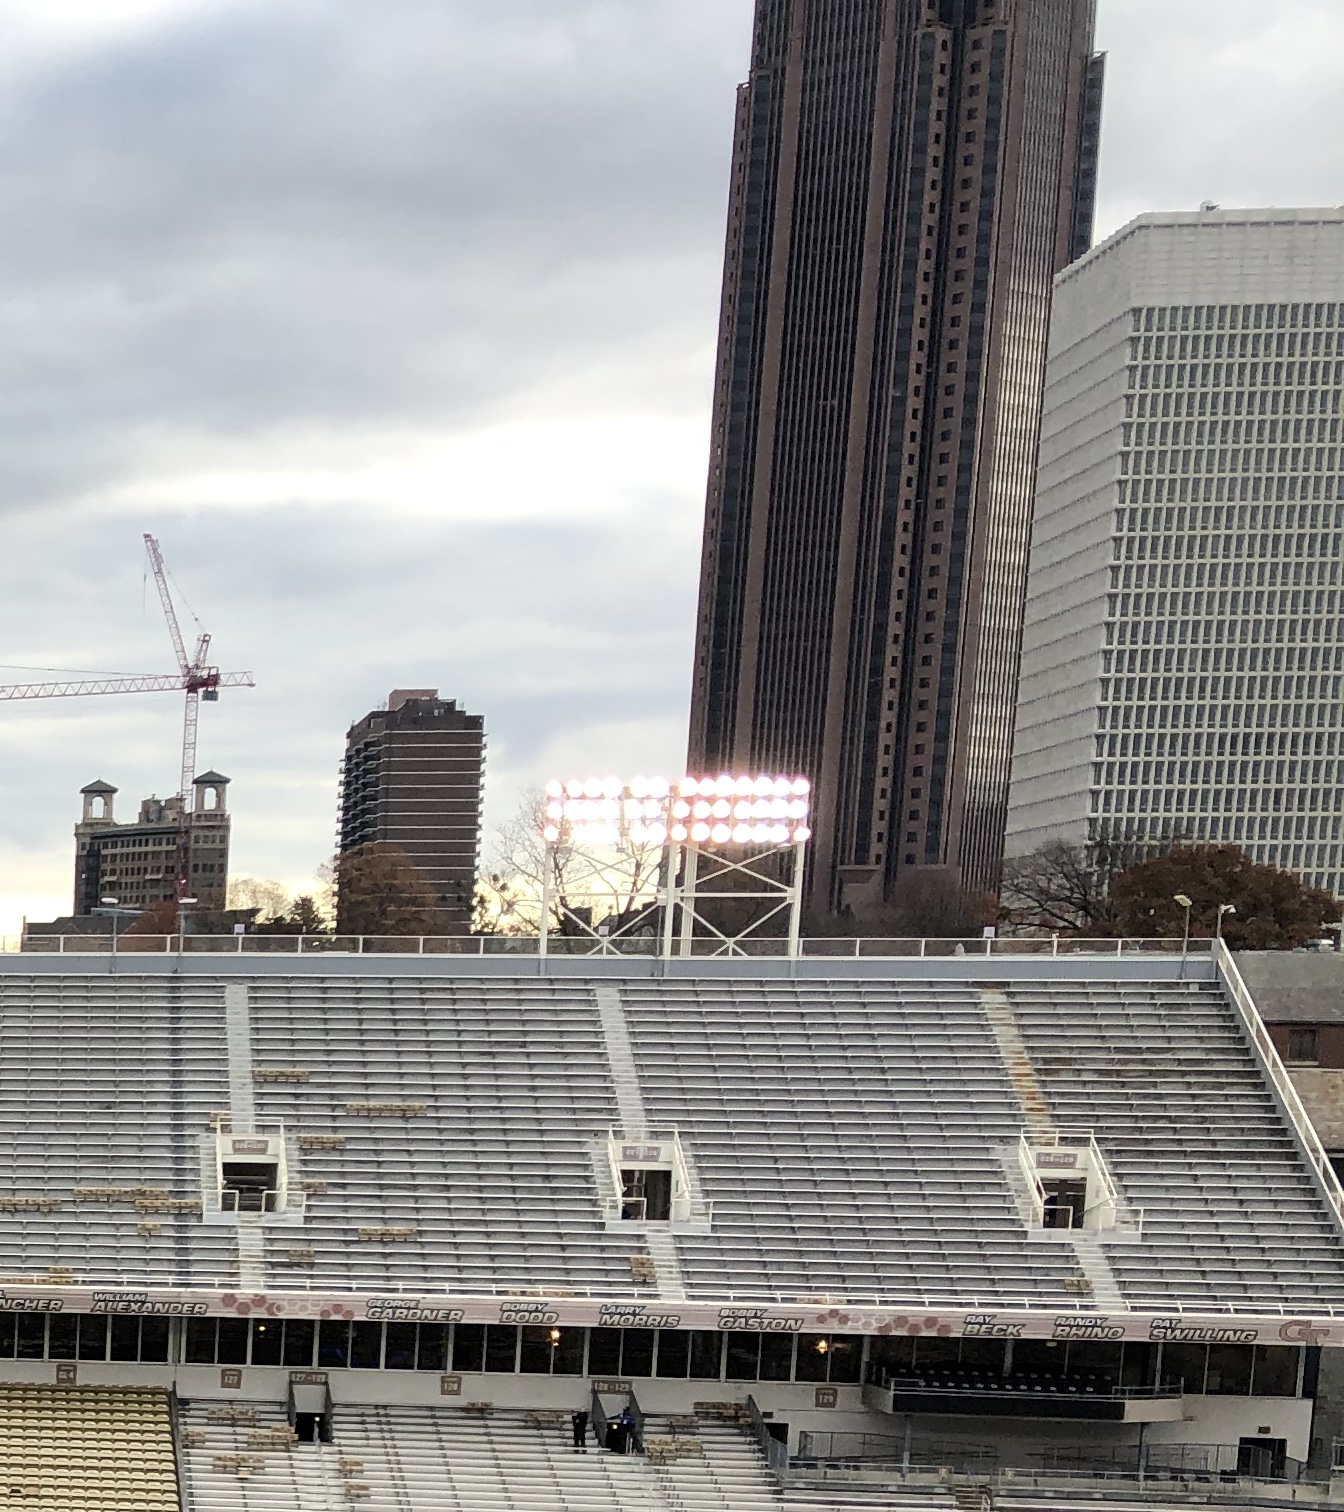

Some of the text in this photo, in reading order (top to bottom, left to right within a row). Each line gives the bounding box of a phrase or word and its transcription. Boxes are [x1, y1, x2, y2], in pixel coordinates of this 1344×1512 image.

[92, 1292, 148, 1301] WILLIAM
[91, 1302, 207, 1315] ALEXANDER
[367, 1299, 420, 1308] GEORGE
[500, 1302, 548, 1311] BOBBY
[366, 1308, 464, 1322] GARDNER
[600, 1305, 646, 1314] LARRY
[719, 1308, 767, 1318] BOBBY
[500, 1311, 558, 1324] DODD
[599, 1314, 680, 1328] MORRIS
[965, 1315, 996, 1324] RAY
[1055, 1316, 1110, 1326] RANDY
[1150, 1319, 1180, 1327] PAT
[718, 1318, 804, 1331] GASTON
[963, 1323, 1026, 1337] BECK
[1053, 1326, 1125, 1339] RHINO
[1149, 1328, 1258, 1342] SWILLING
